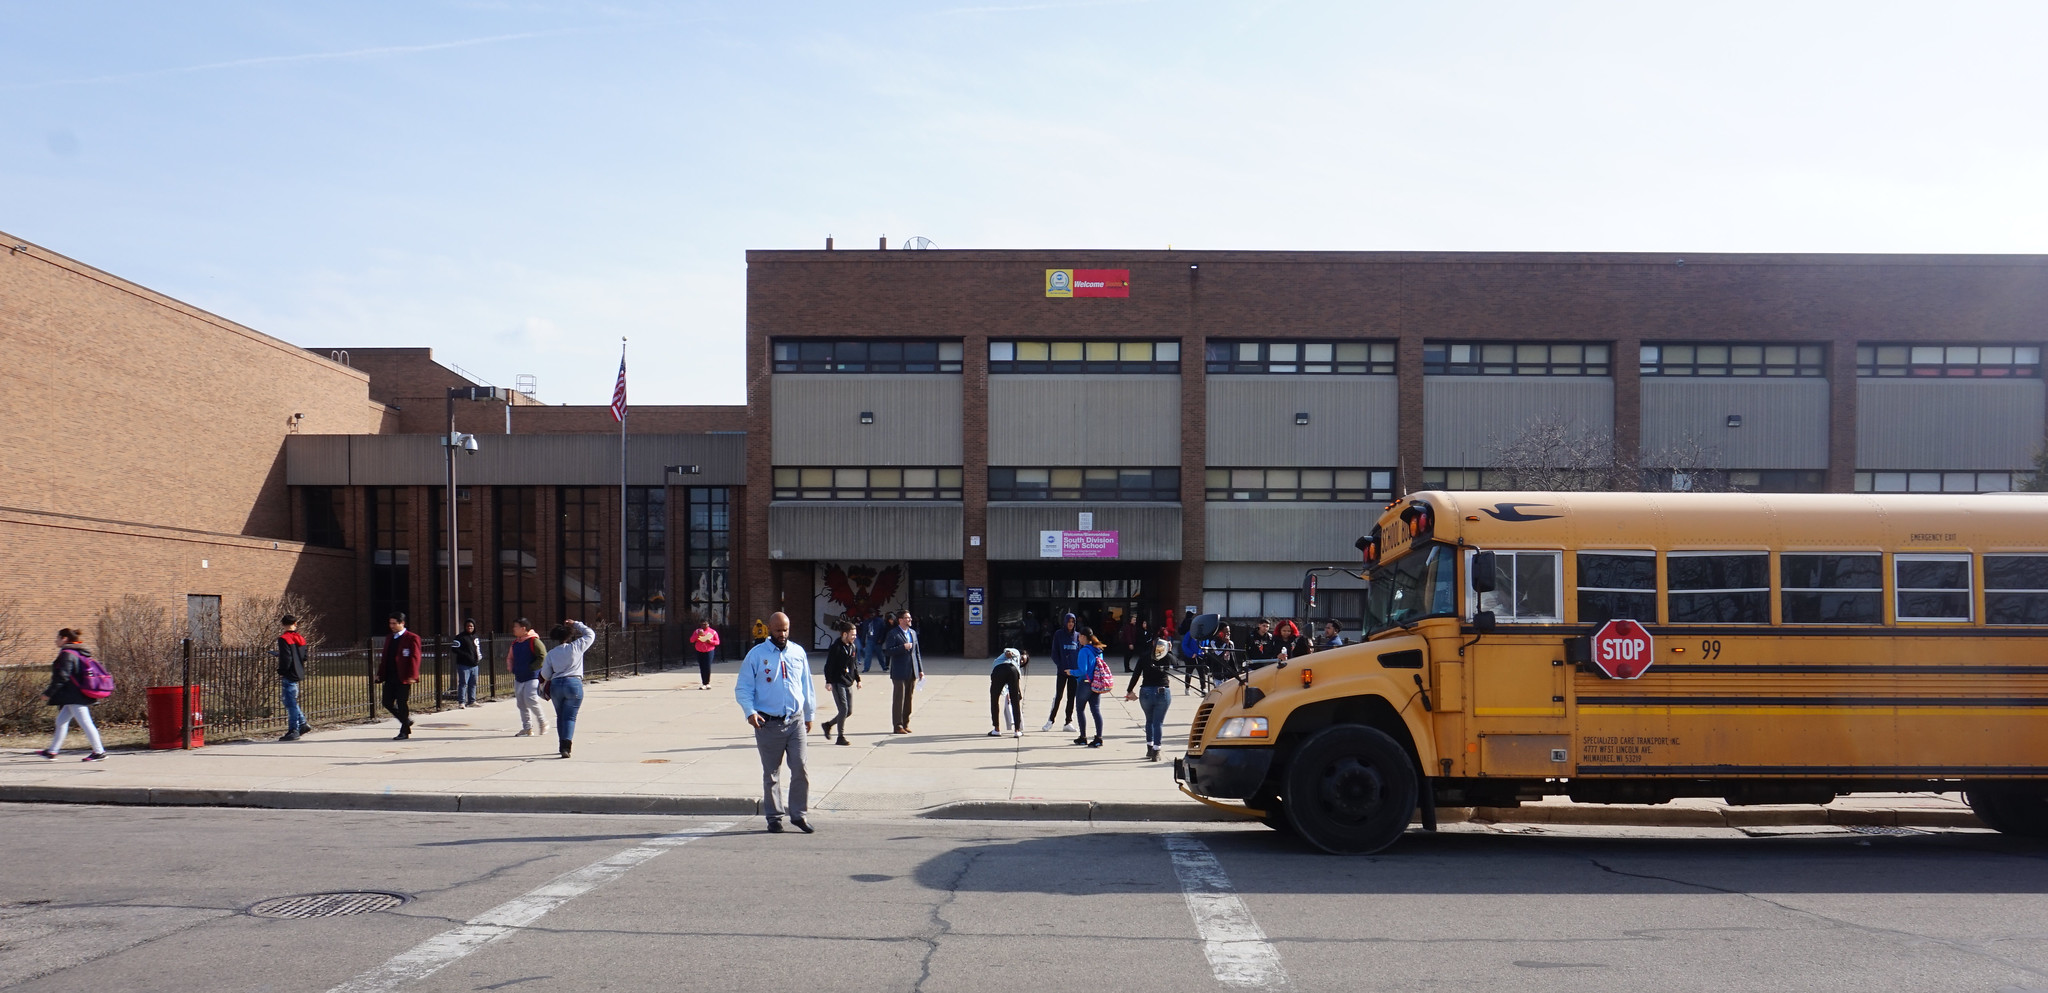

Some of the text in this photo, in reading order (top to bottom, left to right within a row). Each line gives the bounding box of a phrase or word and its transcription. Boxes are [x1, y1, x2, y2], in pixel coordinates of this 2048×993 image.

[1910, 533, 1956, 541] EMERGENCY EXIT
[1602, 638, 1645, 660] STOP
[1702, 640, 1721, 660] 99
[1583, 736, 1618, 745] SPECIALIZED
[1620, 736, 1634, 745] CARE
[1583, 745, 1597, 753] 4777
[1616, 755, 1623, 763] WI
[1625, 755, 1642, 763] 53219
